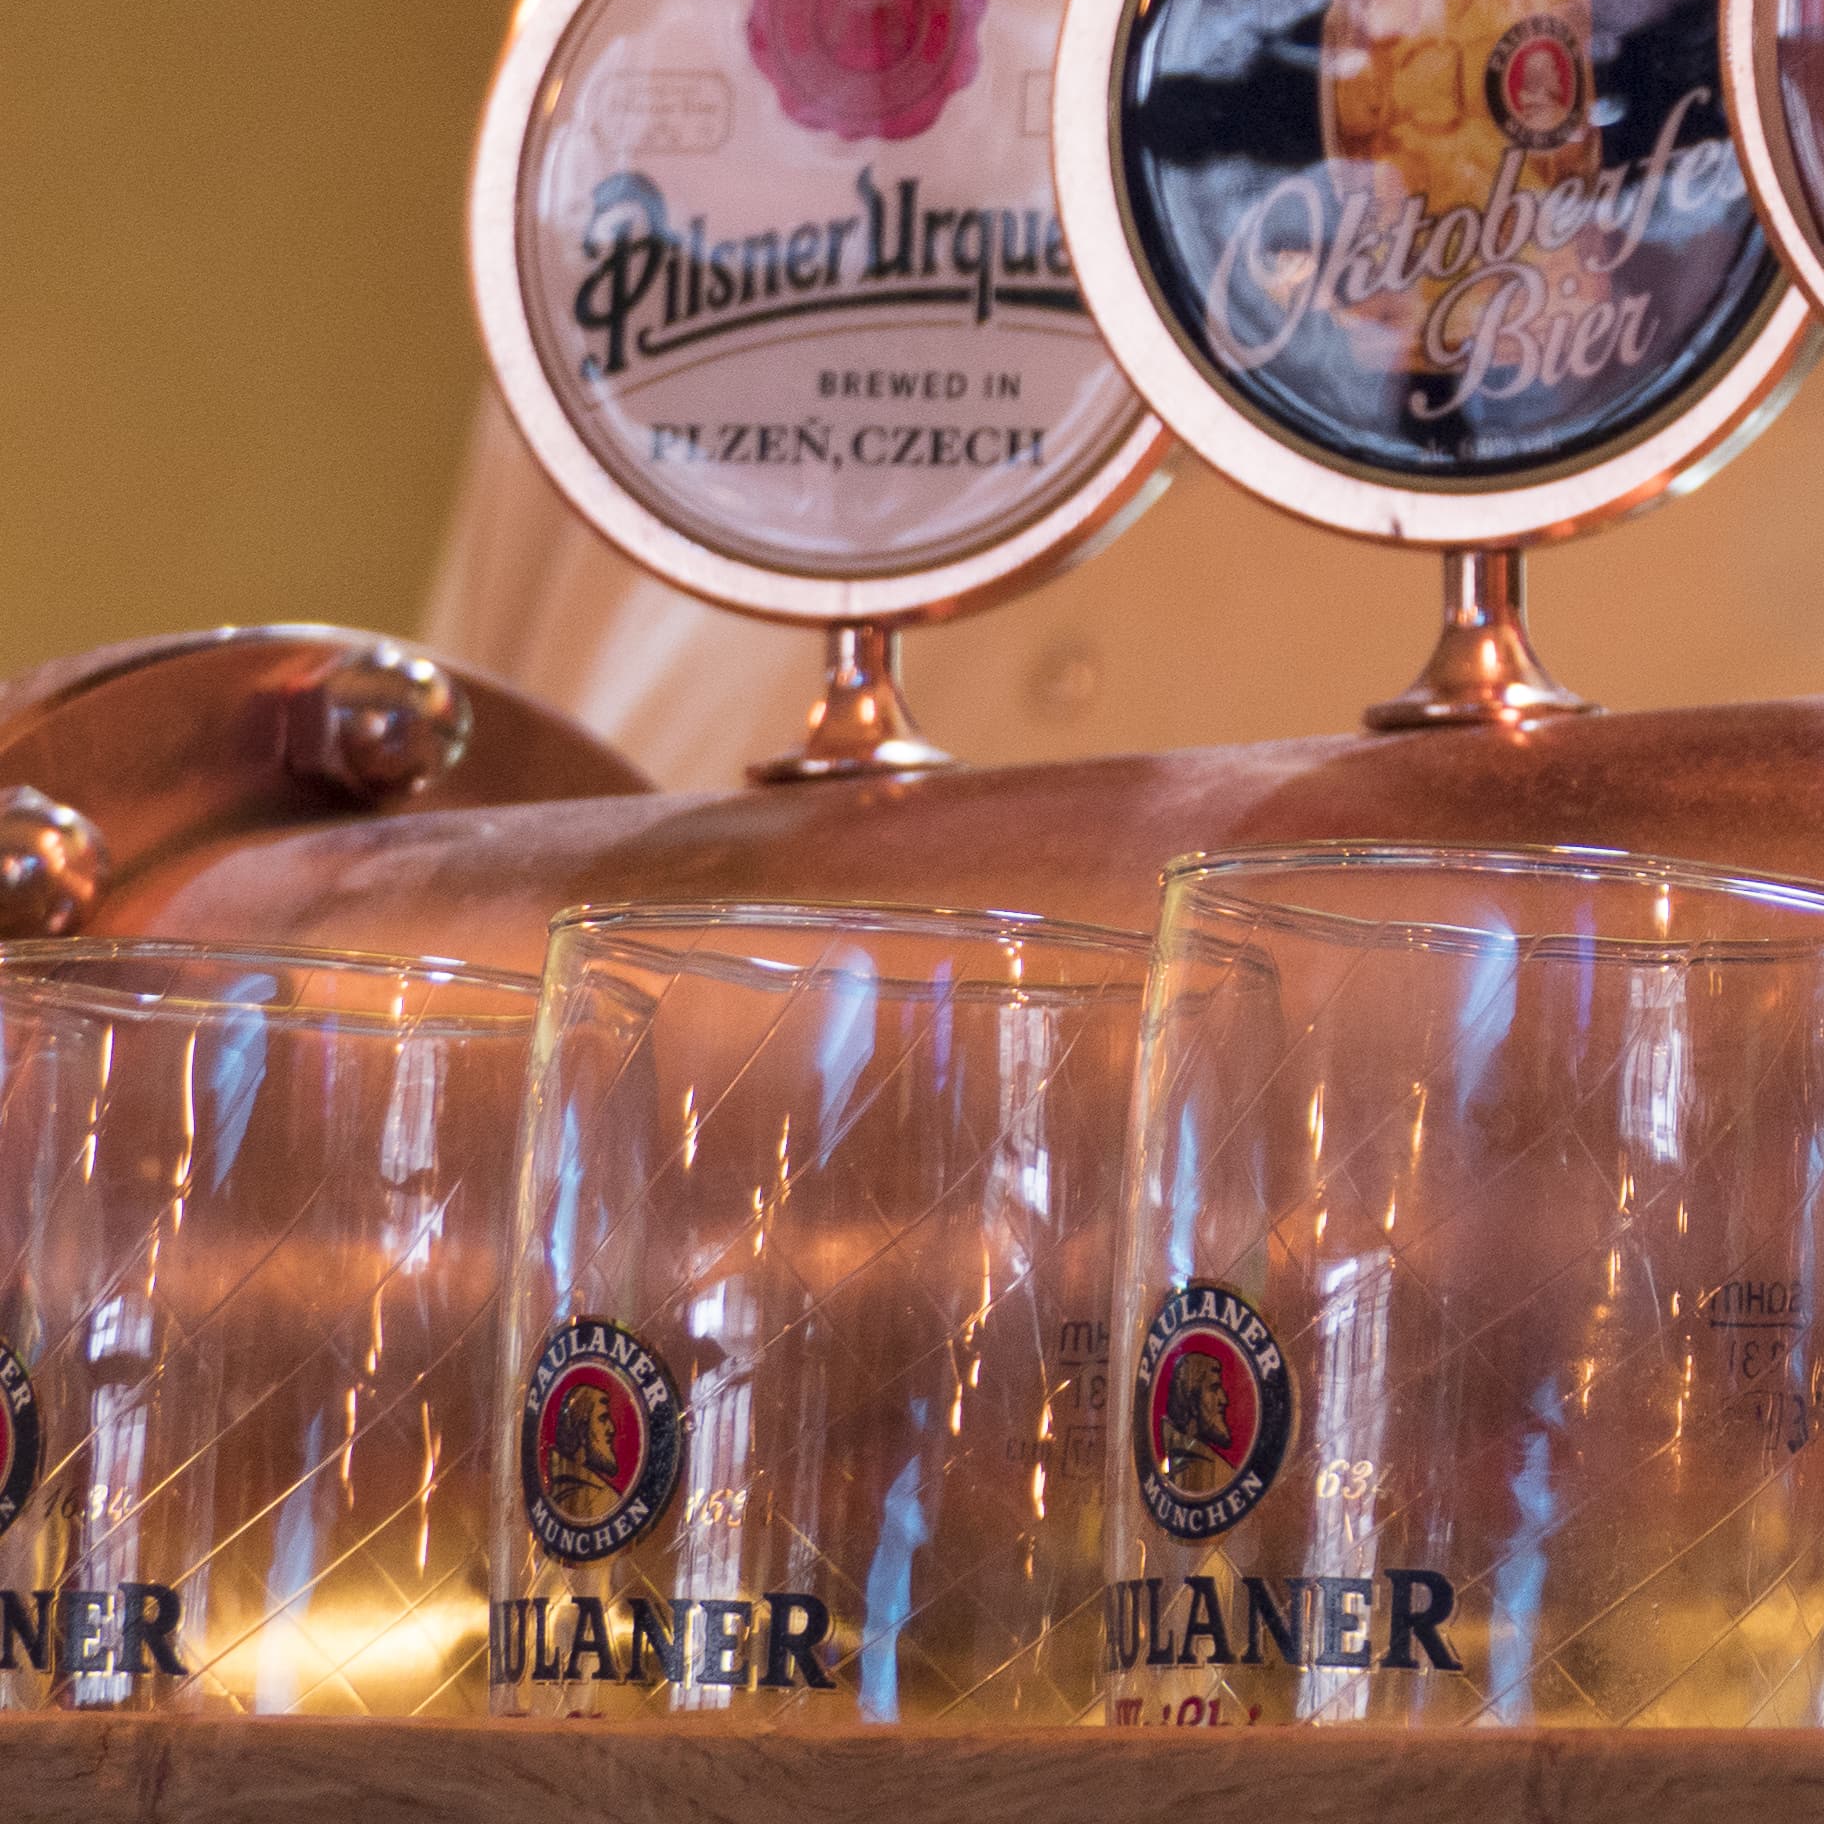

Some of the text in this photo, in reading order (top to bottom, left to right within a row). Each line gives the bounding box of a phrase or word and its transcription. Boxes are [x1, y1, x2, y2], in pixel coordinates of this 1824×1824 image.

[574, 170, 857, 381] Pilsner
[818, 371, 1022, 399] BREWED IN
[1411, 261, 1660, 419] Bier
[852, 424, 1046, 468] CZECH
[527, 1326, 669, 1413] PAULANER
[1139, 1290, 1281, 1387] PAULANER
[491, 1591, 837, 1691] ULANER
